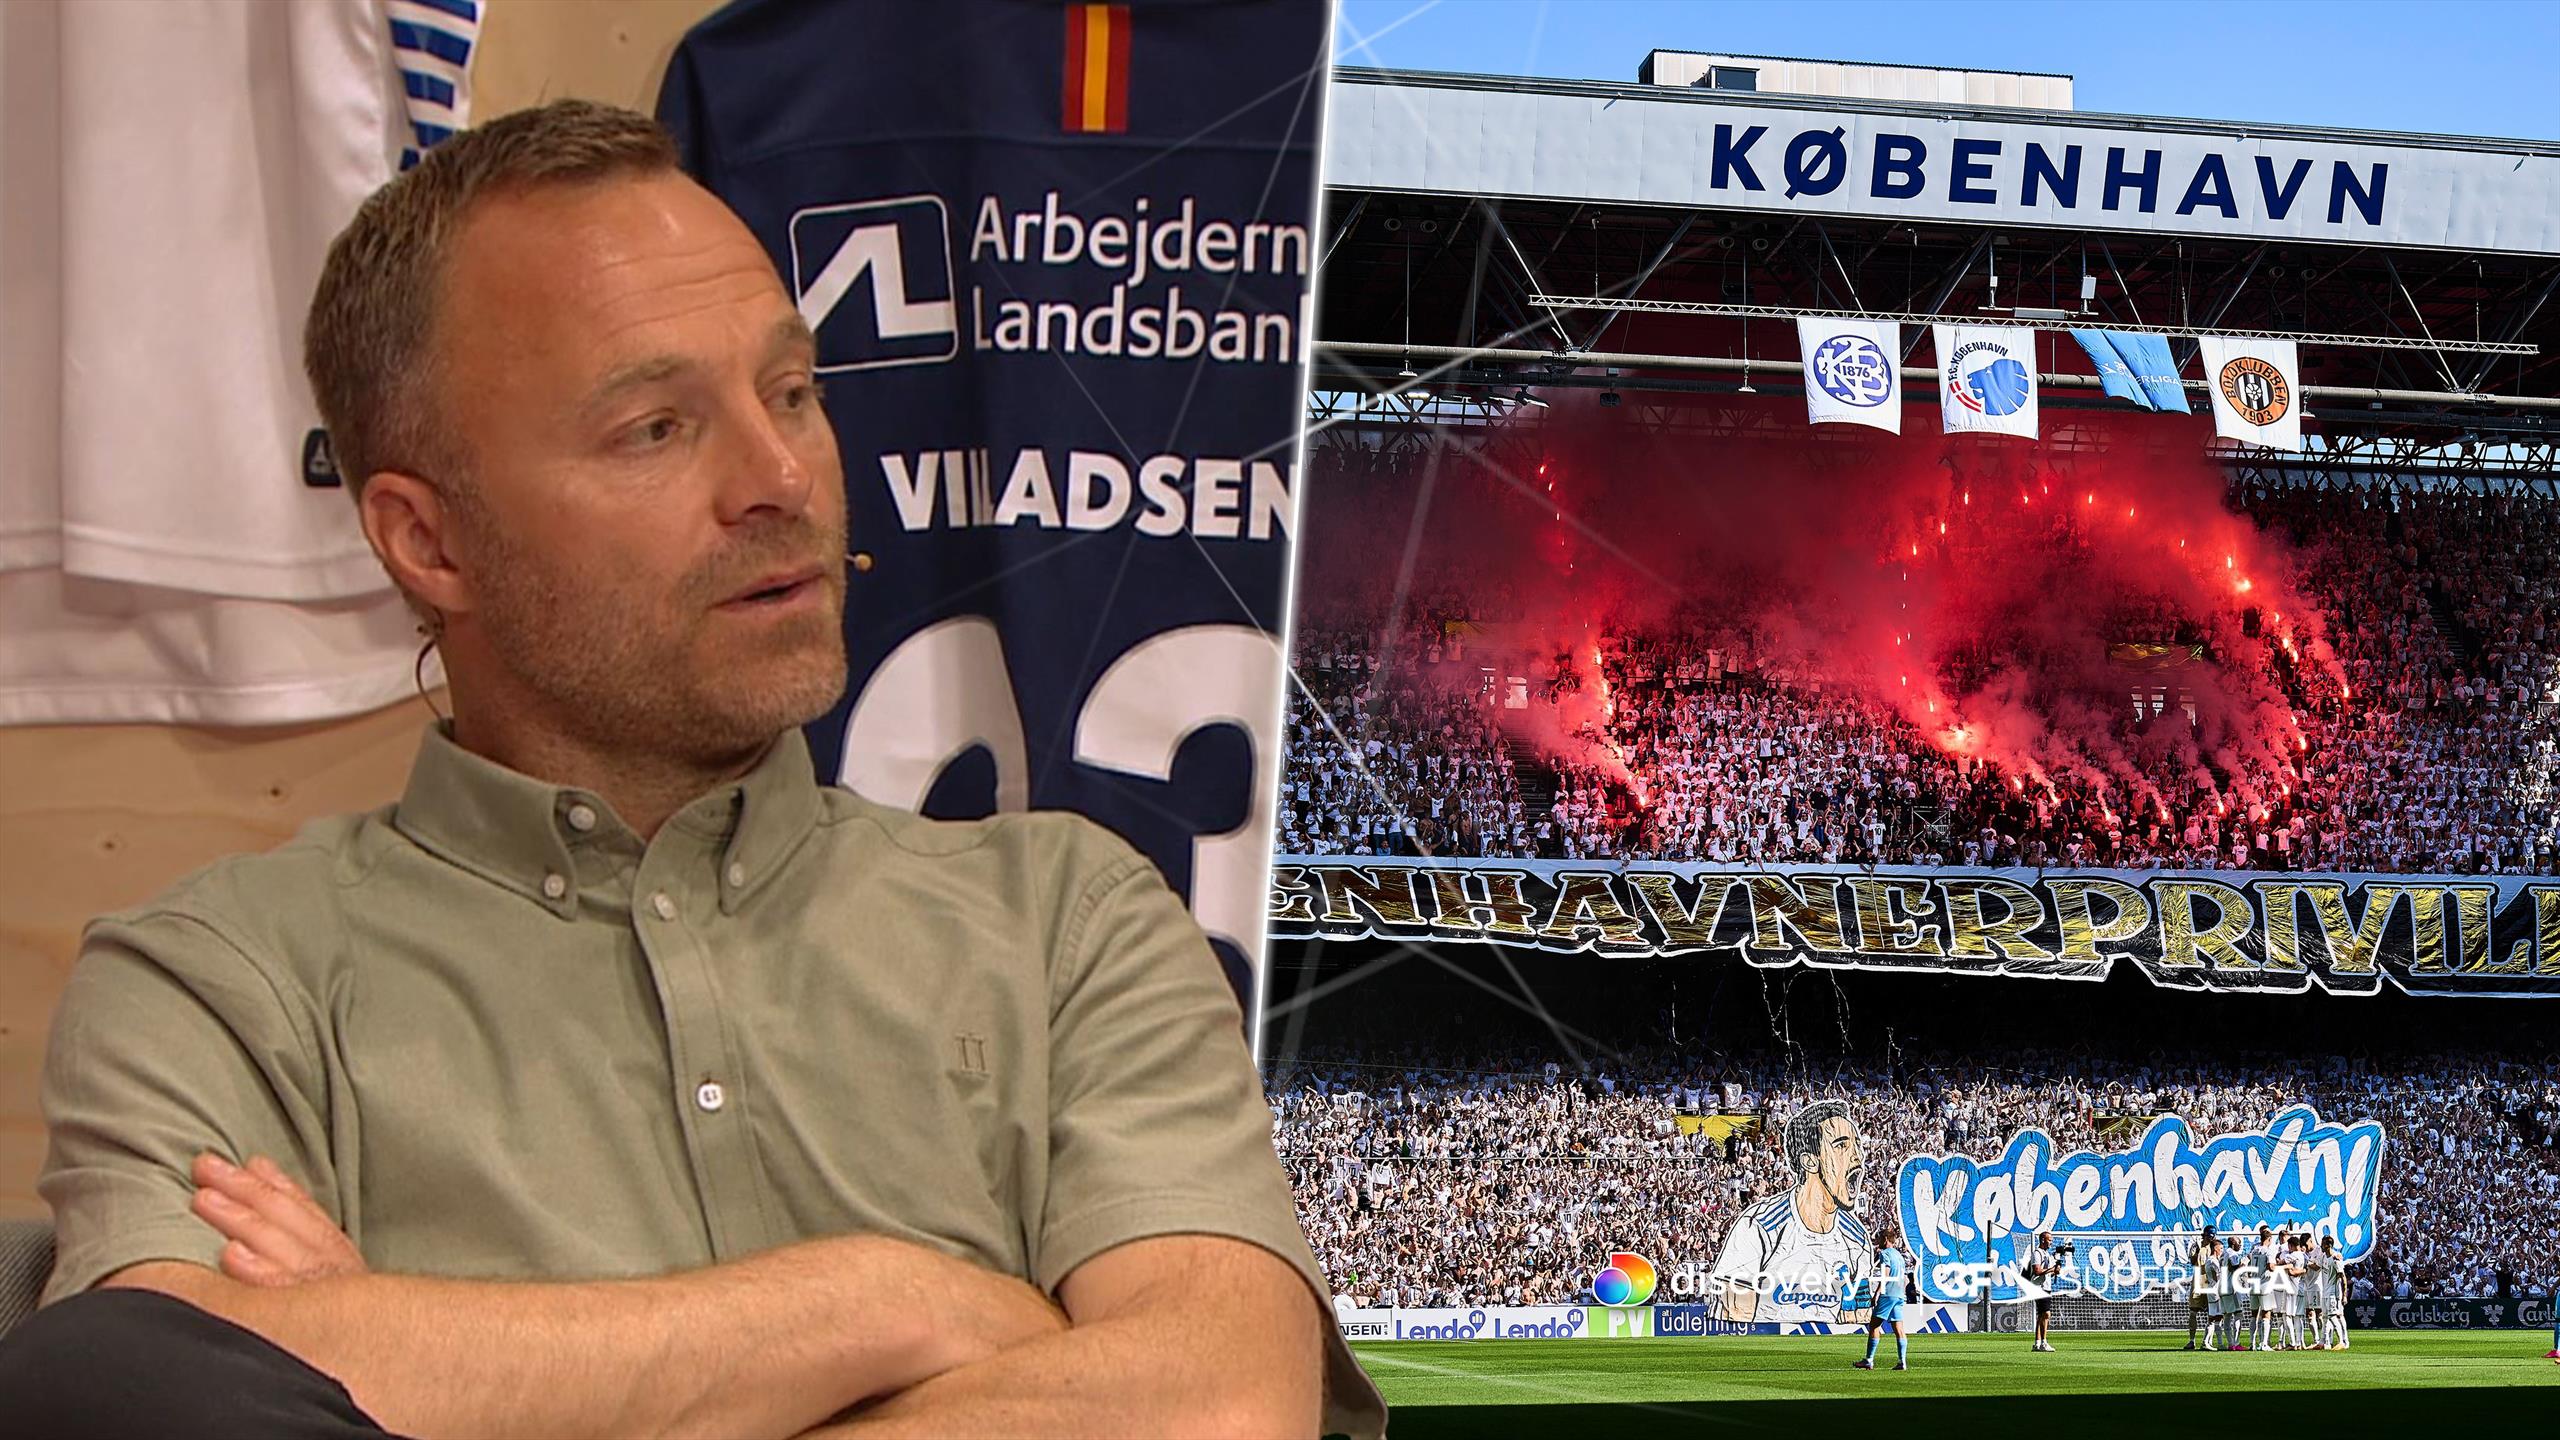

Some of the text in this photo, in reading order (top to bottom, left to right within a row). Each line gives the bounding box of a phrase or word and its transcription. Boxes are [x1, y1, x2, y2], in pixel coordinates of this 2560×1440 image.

[1709, 122, 2389, 227] KØBENHAVN
[970, 191, 1308, 287] Arbejdern
[972, 284, 1311, 364] Landsban
[1842, 365, 1871, 379] 1876
[2241, 408, 2274, 424] 1903
[1912, 1116, 2371, 1257] København!
[1494, 1317, 1573, 1338] Lendo
[1608, 1309, 1646, 1337] PV
[2389, 1301, 2470, 1327] Carlsberg
[1396, 1318, 1475, 1339] Lendo
